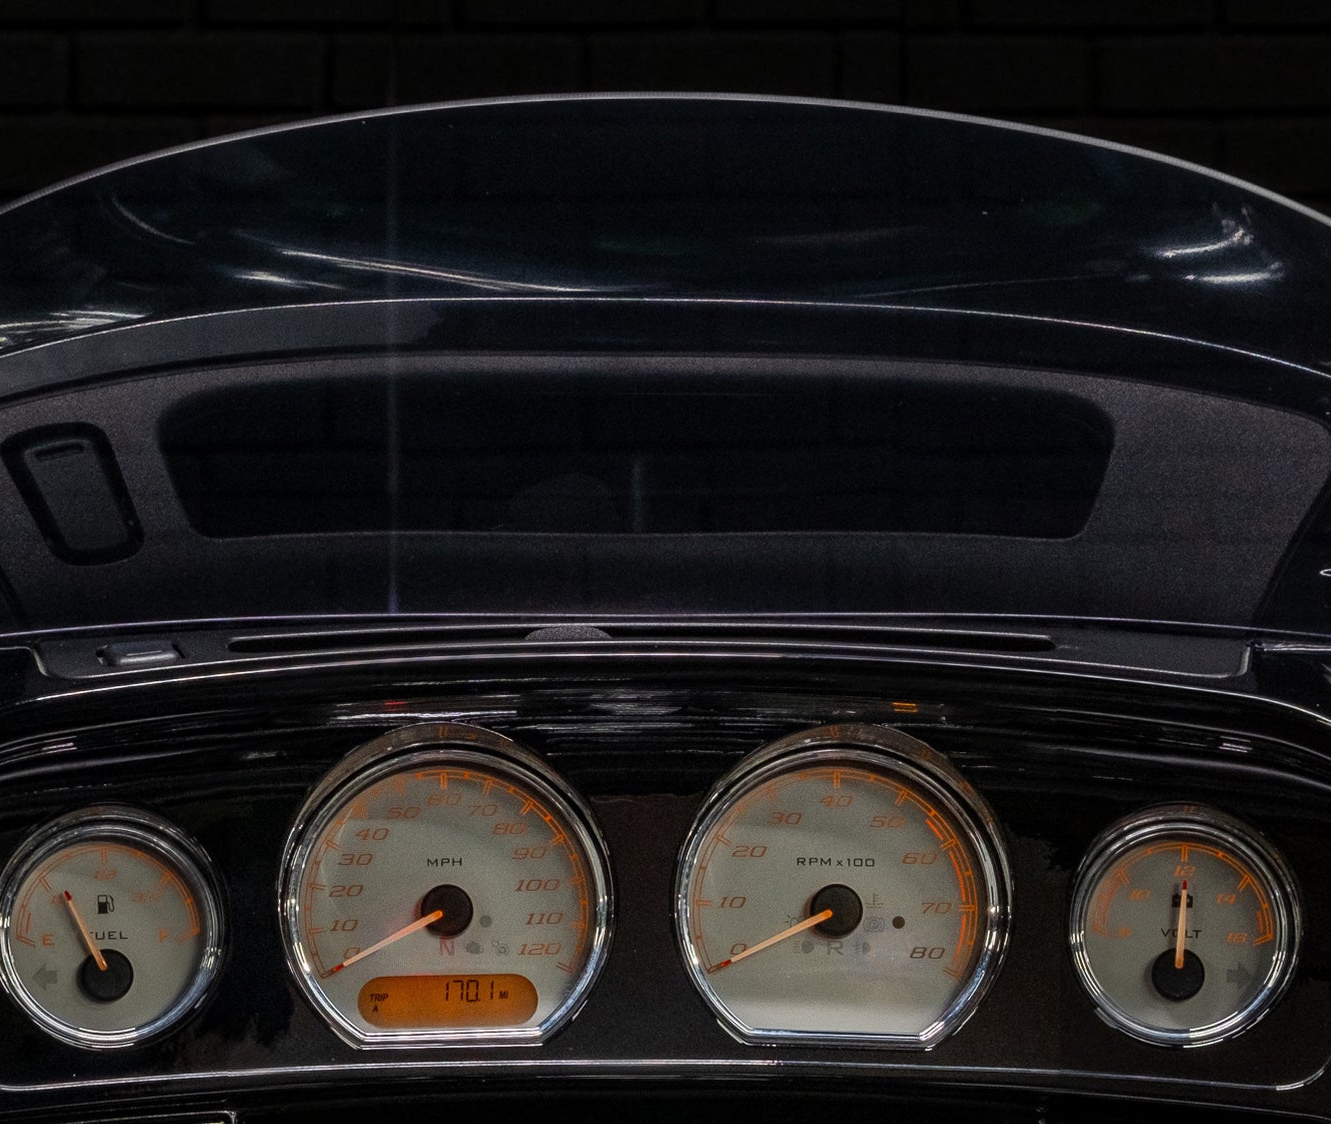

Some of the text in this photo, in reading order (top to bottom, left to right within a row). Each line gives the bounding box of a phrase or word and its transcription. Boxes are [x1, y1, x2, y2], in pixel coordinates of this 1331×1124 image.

[819, 795, 855, 808] 40
[386, 806, 421, 820] 50
[469, 805, 500, 817] 70
[769, 811, 804, 826] 30
[869, 815, 907, 829] 50
[354, 828, 391, 841] 40
[512, 847, 548, 861] 90
[731, 845, 768, 858] 20
[337, 853, 375, 866] 30
[427, 858, 463, 867] MPH
[901, 852, 938, 865] 60
[328, 885, 365, 898] 20
[515, 879, 561, 893] 100
[719, 896, 747, 909] 10
[920, 902, 953, 915] 70
[330, 919, 359, 932] 10
[525, 912, 564, 926] 110
[42, 933, 56, 946] E
[88, 930, 129, 940] UEL
[518, 943, 563, 956] 120
[909, 946, 946, 960] 80
[370, 994, 389, 1002] TRIP
[498, 991, 509, 999] MI
